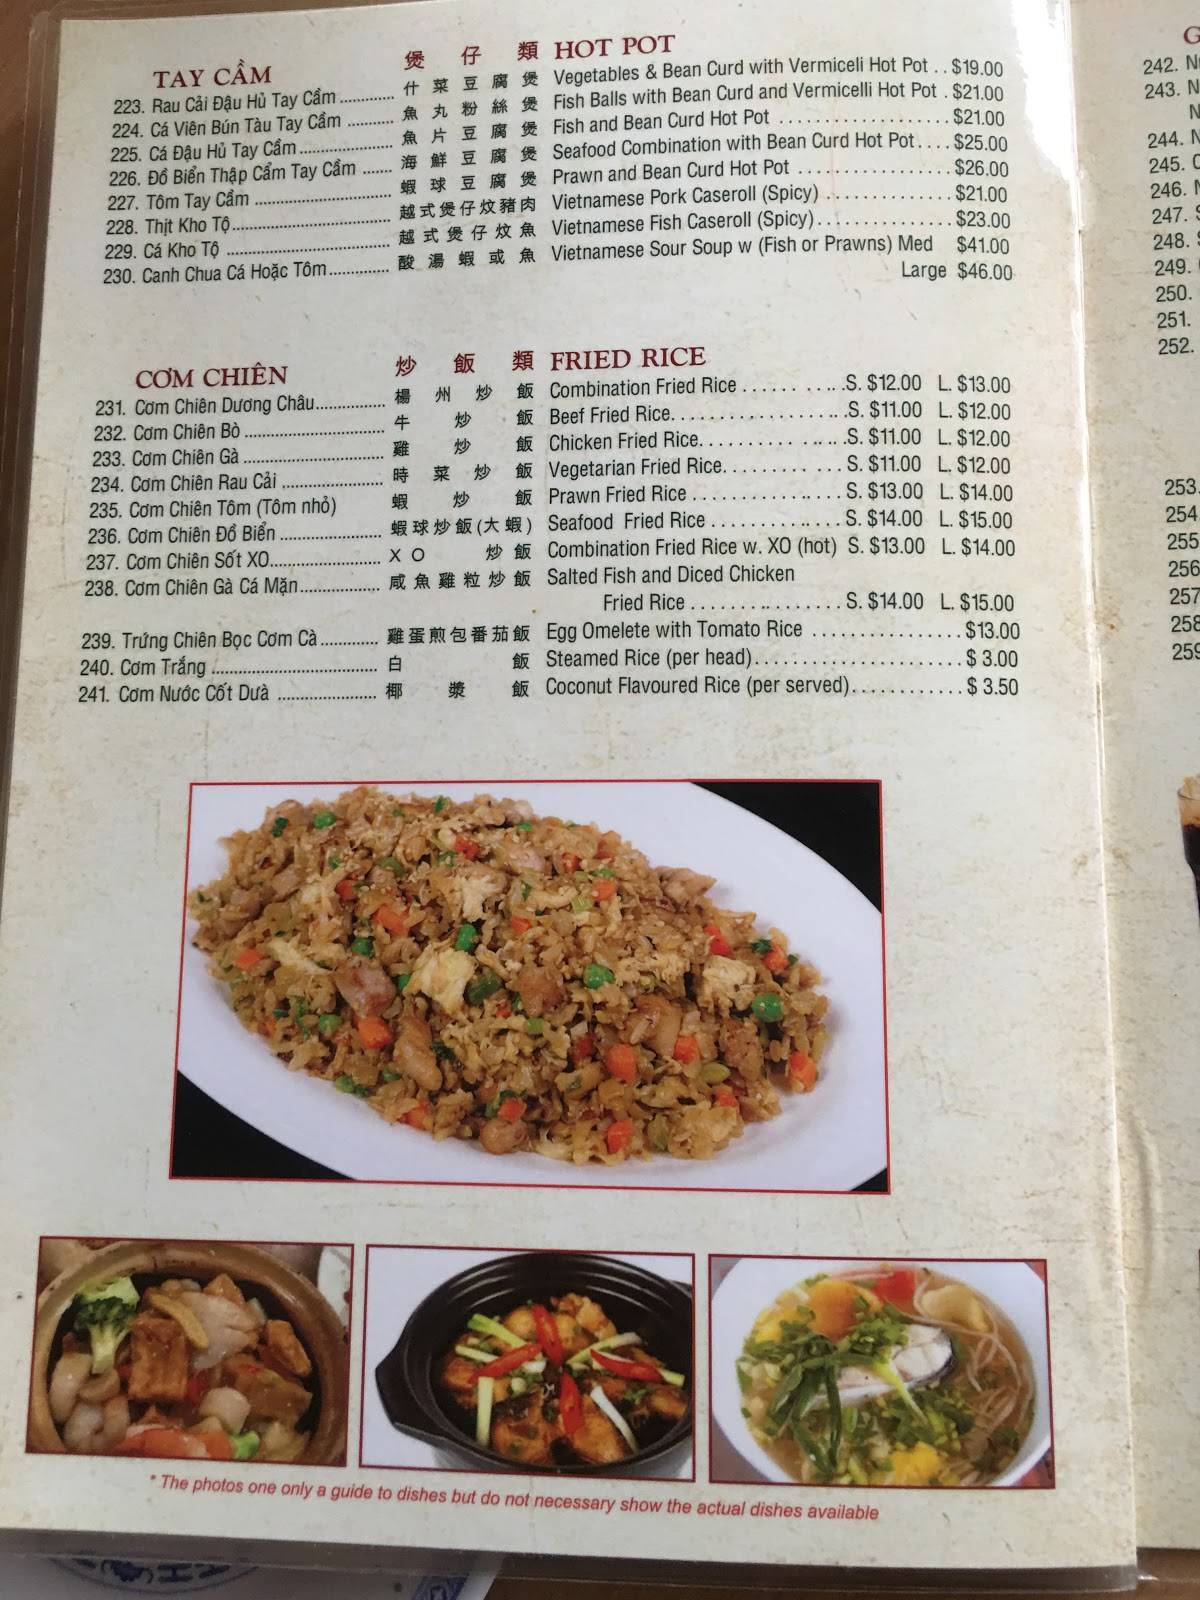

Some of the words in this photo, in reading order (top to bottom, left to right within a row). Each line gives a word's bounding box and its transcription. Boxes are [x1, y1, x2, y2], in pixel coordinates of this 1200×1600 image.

[554, 39, 613, 59] HOT
[622, 35, 675, 55] POT
[153, 70, 204, 88] TAY
[214, 59, 271, 86] CẦM
[1143, 57, 1178, 75] 242.
[554, 93, 584, 110] Fish
[591, 91, 627, 108] Balls
[632, 88, 666, 104] with
[673, 87, 710, 103] Bean
[717, 84, 753, 101] Curd
[759, 83, 787, 99] and
[793, 82, 872, 98] Vermicelli
[879, 82, 905, 97] Hot
[912, 82, 937, 98] Pot
[953, 83, 1003, 102] $21.00
[112, 123, 143, 138] 224.
[151, 122, 168, 137] Cá
[174, 121, 206, 136] Viên
[212, 119, 239, 135] Bún
[244, 117, 271, 133] Tàu
[276, 116, 303, 134] Tay
[308, 111, 340, 129] Cầm
[553, 140, 616, 160] Seafood
[622, 136, 720, 156] Combination
[727, 134, 761, 151] with
[768, 134, 806, 149] Bean
[812, 132, 849, 148] Curd
[856, 132, 883, 148] Hot
[889, 132, 914, 148] Pot
[954, 133, 1007, 152] $25.00
[1148, 131, 1183, 149] 244.
[109, 171, 140, 186] 226.
[148, 168, 168, 185] Đồ
[174, 165, 205, 184] Biển
[210, 167, 247, 185] Thập
[253, 162, 285, 181] Cẩm
[291, 163, 317, 181] Tay
[323, 159, 355, 177] Cầm
[552, 193, 644, 210] Vietnamese
[651, 188, 687, 205] Pork
[692, 185, 756, 203] Caseroll
[762, 184, 818, 205] (Spicy)
[956, 184, 1007, 203] $21.00
[1151, 181, 1186, 199] 246.
[106, 219, 138, 235] 228.
[145, 218, 173, 236] Thịt
[179, 218, 207, 232] Kho
[212, 216, 232, 234] Tộ
[552, 245, 644, 261] Vietnamese
[650, 240, 687, 257] Sour
[693, 239, 732, 257] Soup
[738, 241, 752, 253] w
[759, 236, 796, 256] (Fish
[802, 239, 819, 252] or
[825, 235, 892, 255] Prawns)
[899, 235, 933, 252] Med
[957, 236, 1009, 254] $41.00
[1154, 232, 1189, 250] 248.
[103, 268, 135, 284] 230.
[143, 267, 179, 283] Canh
[185, 266, 221, 282] Chua
[227, 264, 245, 280] Cá
[251, 263, 288, 281] Hoặc
[293, 261, 326, 277] Tôm
[902, 261, 946, 281] Large
[958, 261, 1012, 281] $46.00
[1156, 284, 1192, 302] 250.
[1159, 337, 1194, 355] 252.
[550, 350, 631, 371] FRIED
[641, 347, 706, 367] RICE
[136, 368, 194, 389] CƠM
[203, 362, 288, 387] CHIÊN
[549, 459, 635, 481] Vegetarian
[642, 458, 680, 475] Fried
[687, 457, 722, 474] Rice
[869, 454, 921, 474] $11.00
[957, 455, 1010, 475] $12.00
[91, 476, 123, 493] 234.
[131, 476, 165, 492] Cơm
[171, 475, 212, 491] Chiên
[219, 474, 247, 490] Rau
[253, 471, 276, 489] Cải
[548, 513, 613, 531] Seafood
[625, 512, 663, 529] Fried
[671, 511, 705, 528] Rice
[867, 508, 923, 528] $14.00
[959, 510, 1012, 529] $15.00
[88, 528, 120, 544] 236.
[128, 528, 162, 544] Cơm
[168, 527, 210, 543] Chiên
[216, 523, 237, 542] Đồ
[242, 521, 275, 541] Biển
[548, 568, 597, 585] Salted
[604, 567, 636, 584] Fish
[642, 566, 671, 583] and
[678, 565, 723, 583] Diced
[729, 564, 794, 582] Chicken
[85, 580, 118, 596] 238.
[125, 580, 159, 596] Cơm
[166, 579, 208, 595] Chiên
[214, 578, 233, 595] Gà
[240, 577, 258, 594] Cá
[264, 577, 299, 596] Mặn
[604, 594, 643, 611] Fried
[650, 593, 684, 610] Rice
[868, 591, 923, 611] $14.00
[960, 592, 1014, 613] $15.00
[82, 633, 115, 650] 239.
[122, 632, 168, 652] Trứng
[174, 632, 216, 648] Chiên
[222, 631, 251, 650] Bọc
[257, 630, 292, 647] Cơm
[298, 629, 317, 646] Cà
[547, 623, 576, 643] Egg
[583, 622, 650, 639] Omelete
[656, 620, 691, 638] with
[697, 620, 760, 637] Tomato
[767, 620, 802, 637] Rice
[966, 620, 1020, 640] $13.00
[162, 1475, 188, 1490] The
[193, 1477, 243, 1493] photos
[248, 1482, 276, 1494] one
[281, 1482, 313, 1499] only
[317, 1486, 326, 1497] a
[331, 1484, 373, 1501] guide
[378, 1486, 392, 1500] to
[397, 1486, 446, 1503] dishes
[452, 1489, 476, 1504] but
[481, 1490, 500, 1505] do
[505, 1493, 530, 1507] not
[534, 1496, 615, 1514] necessary
[620, 1497, 663, 1512] show
[667, 1499, 692, 1514] the
[697, 1501, 746, 1516] actual
[750, 1502, 802, 1518] dishes
[808, 1504, 879, 1520] available
